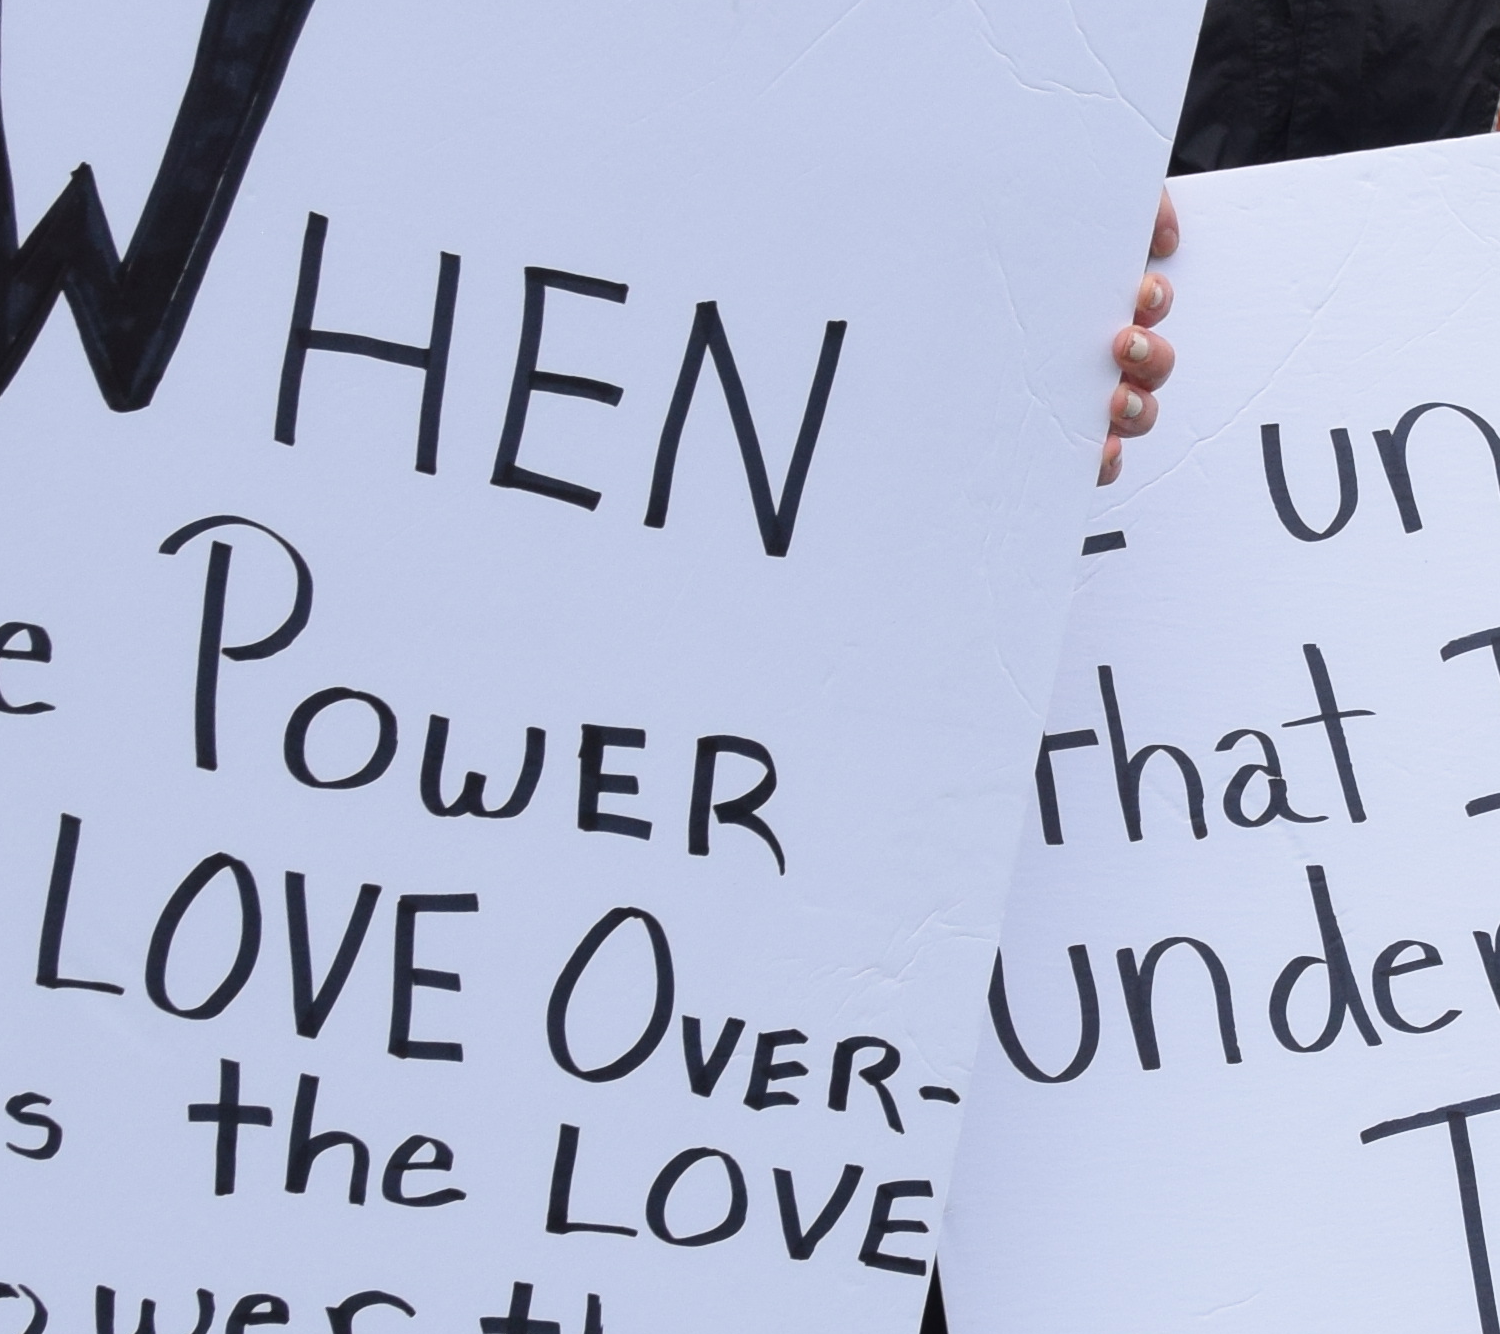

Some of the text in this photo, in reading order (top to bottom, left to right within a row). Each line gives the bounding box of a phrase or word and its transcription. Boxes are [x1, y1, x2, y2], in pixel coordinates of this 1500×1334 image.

[36, 813, 478, 1062] LOVE
[188, 1059, 466, 1207] the
[546, 1124, 934, 1276] LOVE
